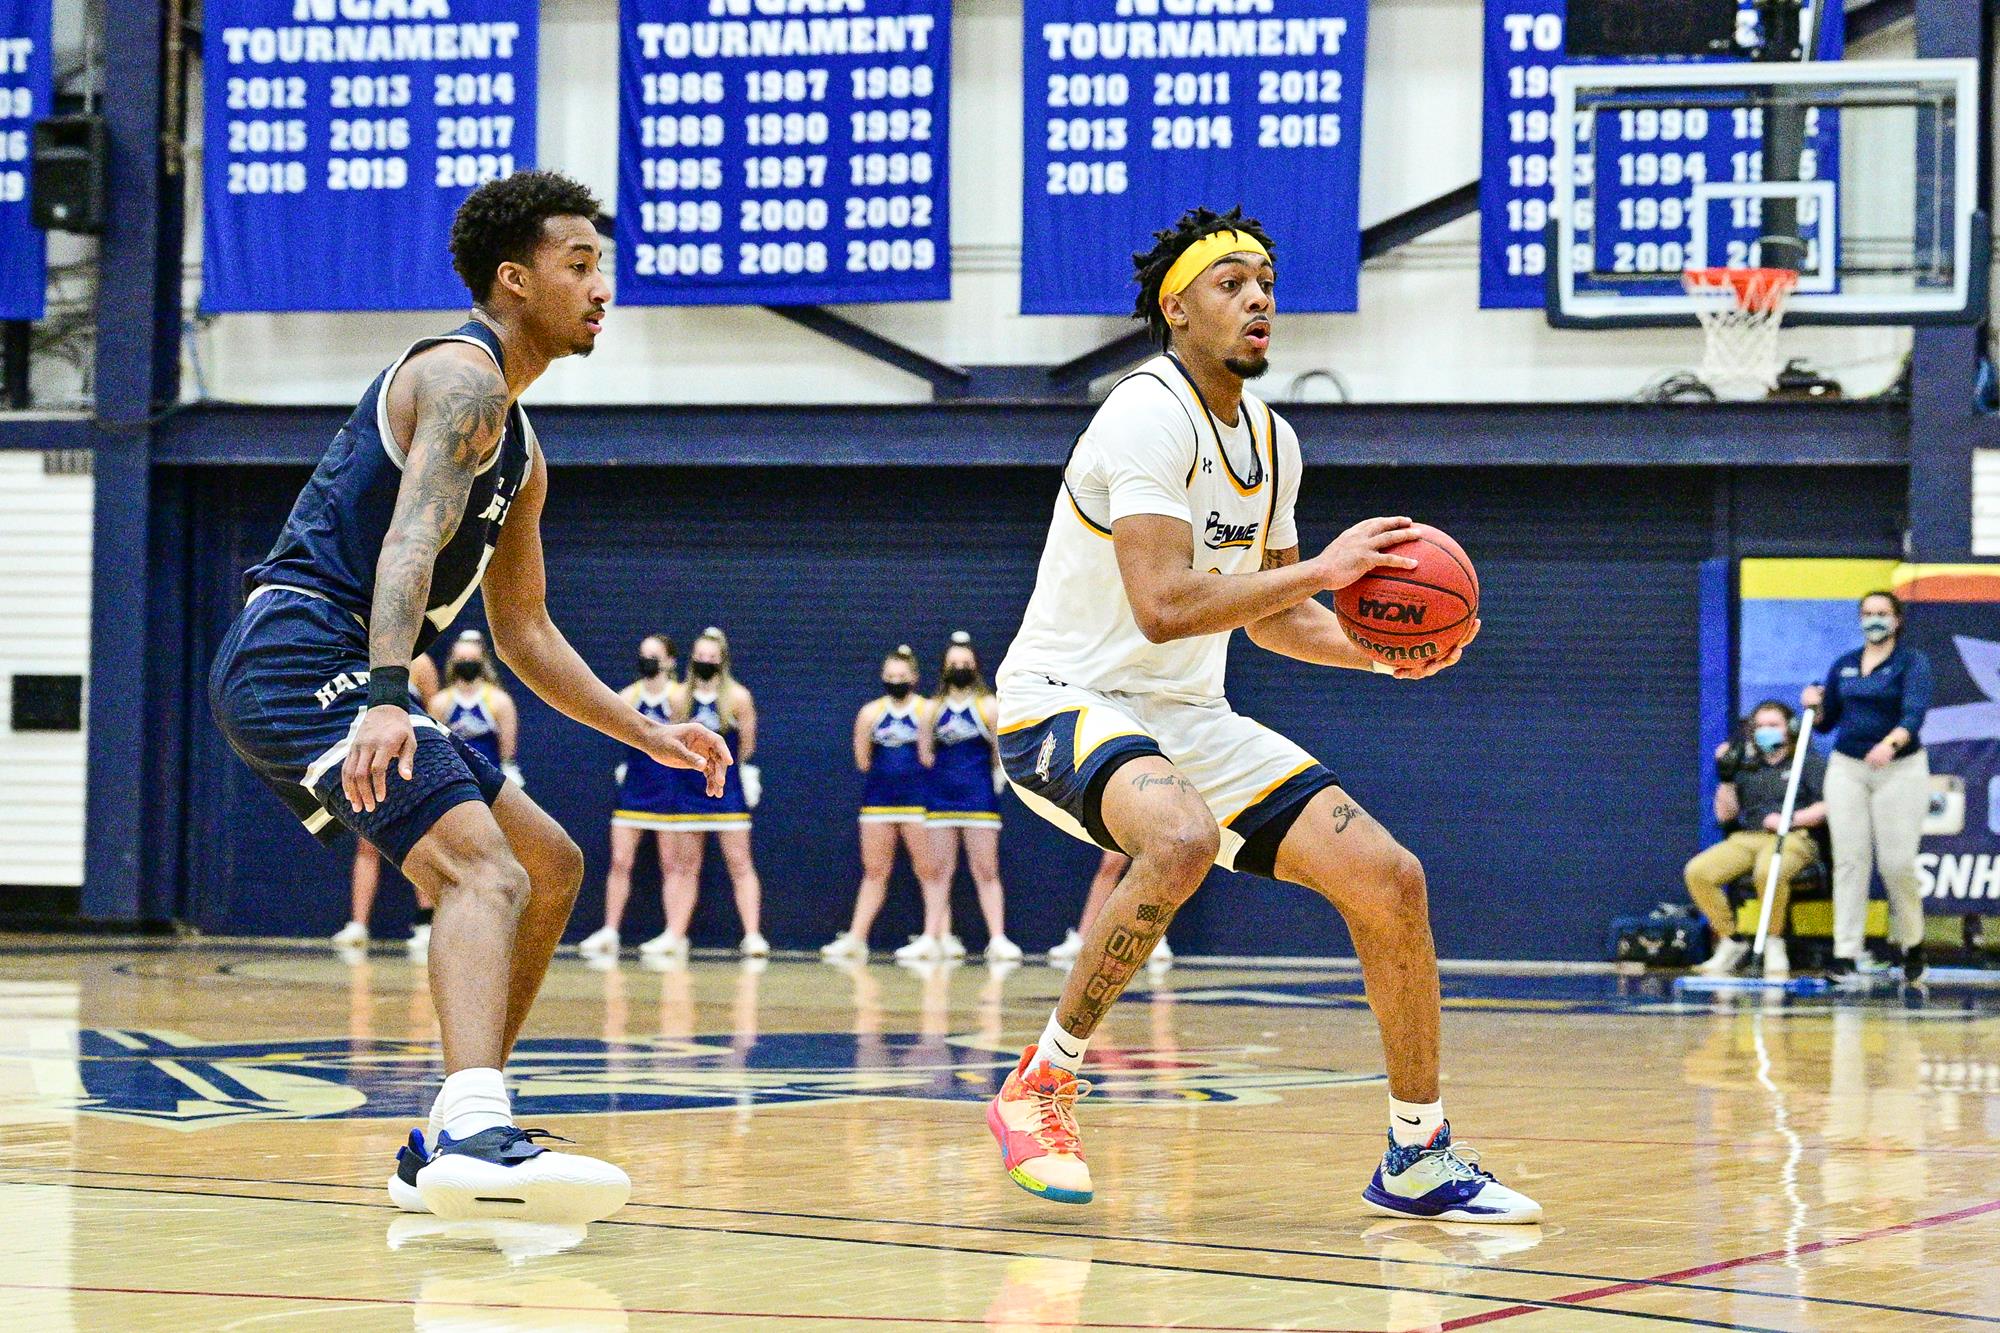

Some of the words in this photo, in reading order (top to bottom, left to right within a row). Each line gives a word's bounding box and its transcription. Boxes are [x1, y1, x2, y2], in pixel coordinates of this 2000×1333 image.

[223, 23, 519, 64] TOURNAMENT
[637, 15, 934, 58] TOURNAMENT
[1043, 17, 1347, 60] TOURNAMENT
[227, 77, 306, 109] 2012
[330, 75, 411, 108] 2013
[434, 73, 515, 106] 2014
[1047, 73, 1129, 107] 2010
[1153, 72, 1230, 106] 2011
[1258, 70, 1342, 104] 2012
[228, 120, 307, 152] 2015
[330, 118, 410, 151] 2016
[436, 116, 514, 149] 2017
[745, 112, 828, 145] 1990
[851, 109, 932, 143] 1992
[1047, 118, 1127, 150] 2013
[1151, 116, 1232, 149] 2014
[1258, 114, 1340, 147] 2015
[1618, 108, 1708, 141] 1990
[228, 162, 306, 194] 2018
[327, 157, 408, 190] 2019
[641, 157, 722, 190] 1995
[744, 155, 827, 188] 1997
[1046, 161, 1128, 195] 2016
[1618, 152, 1707, 186] 1994
[640, 201, 722, 233] 1999
[740, 199, 828, 231] 2000
[845, 195, 932, 229] 2002
[635, 243, 723, 275] 2006
[739, 241, 828, 274] 2008
[846, 238, 935, 272] 2009
[1506, 243, 1594, 276] 199
[1358, 595, 1427, 625] NCAA
